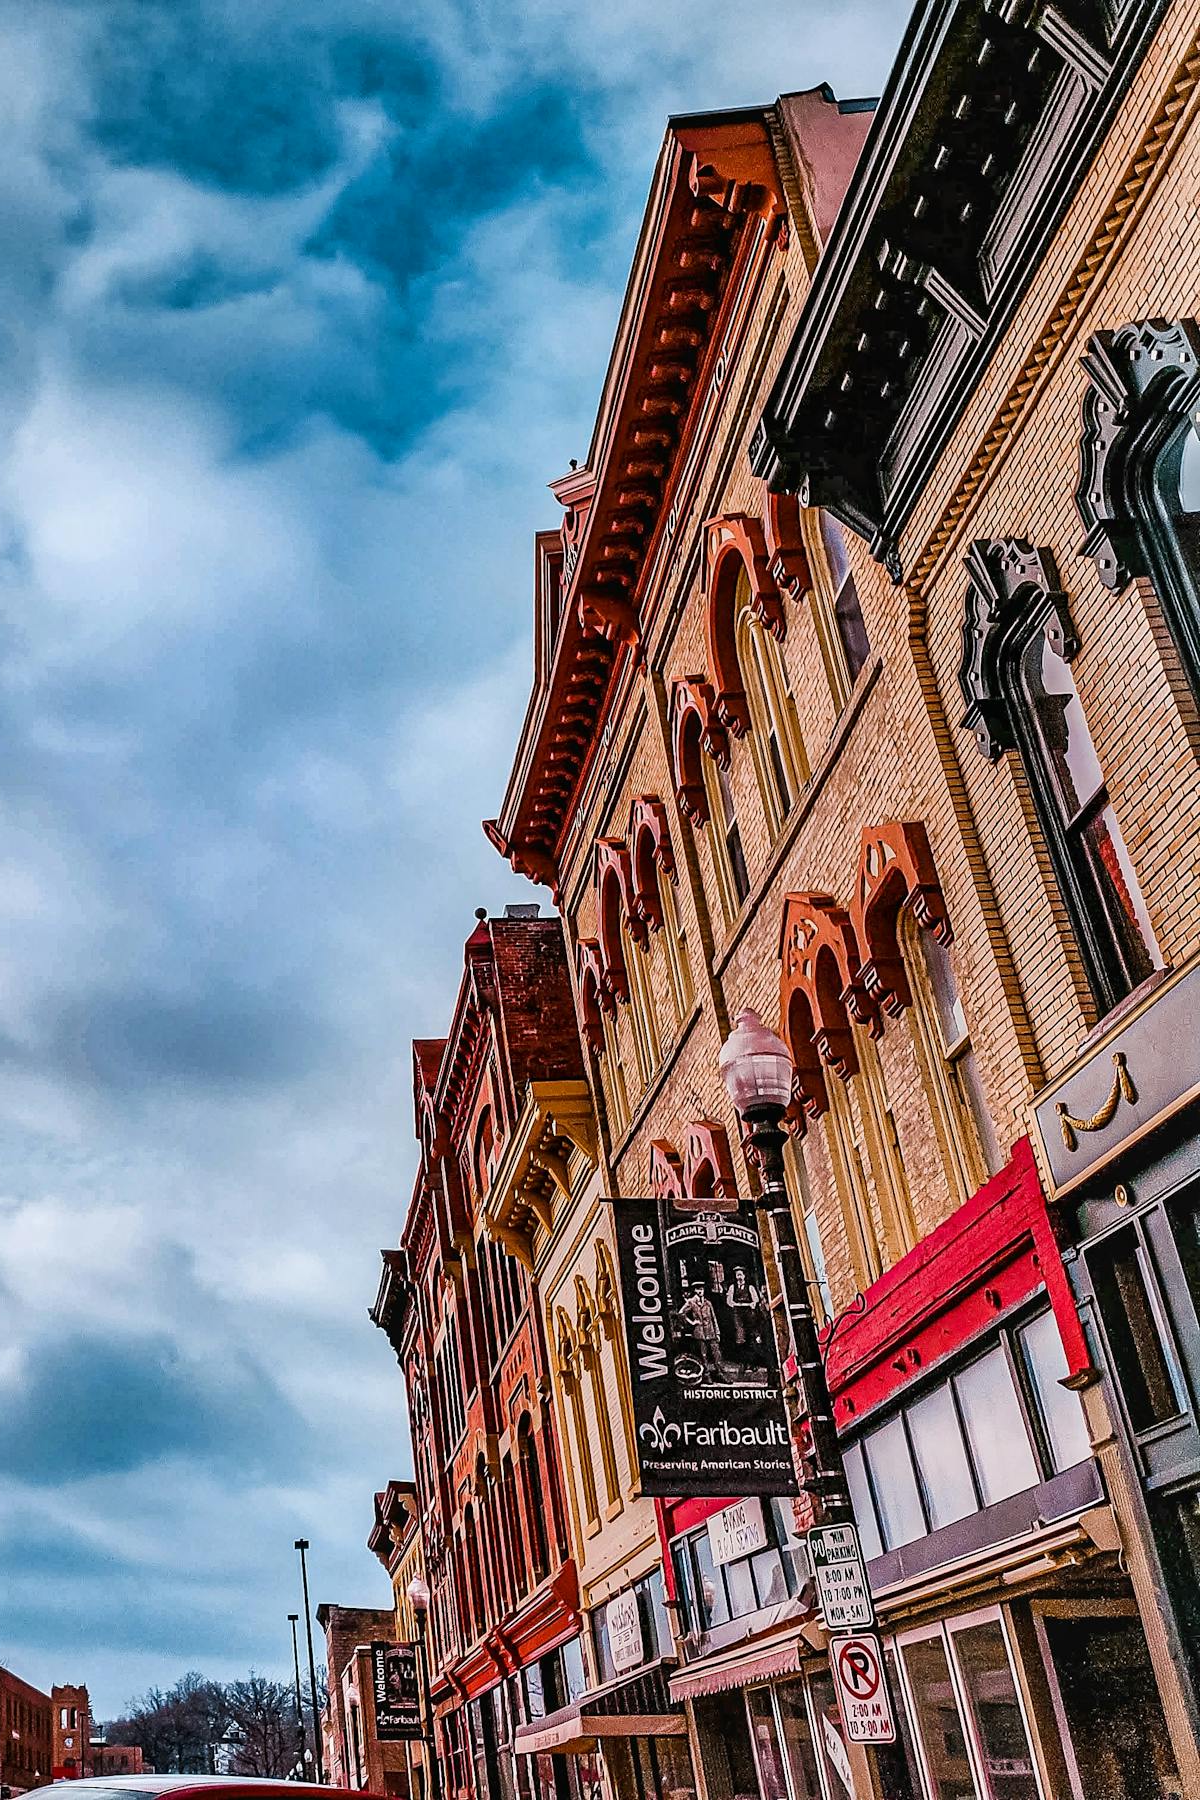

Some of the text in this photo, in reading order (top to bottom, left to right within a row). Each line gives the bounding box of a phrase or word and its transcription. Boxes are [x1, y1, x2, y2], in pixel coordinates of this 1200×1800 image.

[631, 1224, 669, 1381] Welcome
[684, 1389, 778, 1400] HISTORIC DISTRICT
[683, 1420, 788, 1446] Faribault
[642, 1459, 791, 1471] Preserving American Stories
[811, 1539, 826, 1558] 90
[826, 1545, 857, 1560] PARKING
[825, 1567, 855, 1583] 8:00 AM
[824, 1585, 864, 1603] TO 7:00 PM
[375, 1649, 387, 1703] Welcome
[851, 1703, 882, 1717] 2:00 AM
[850, 1720, 891, 1735] TO 5:00 AM
